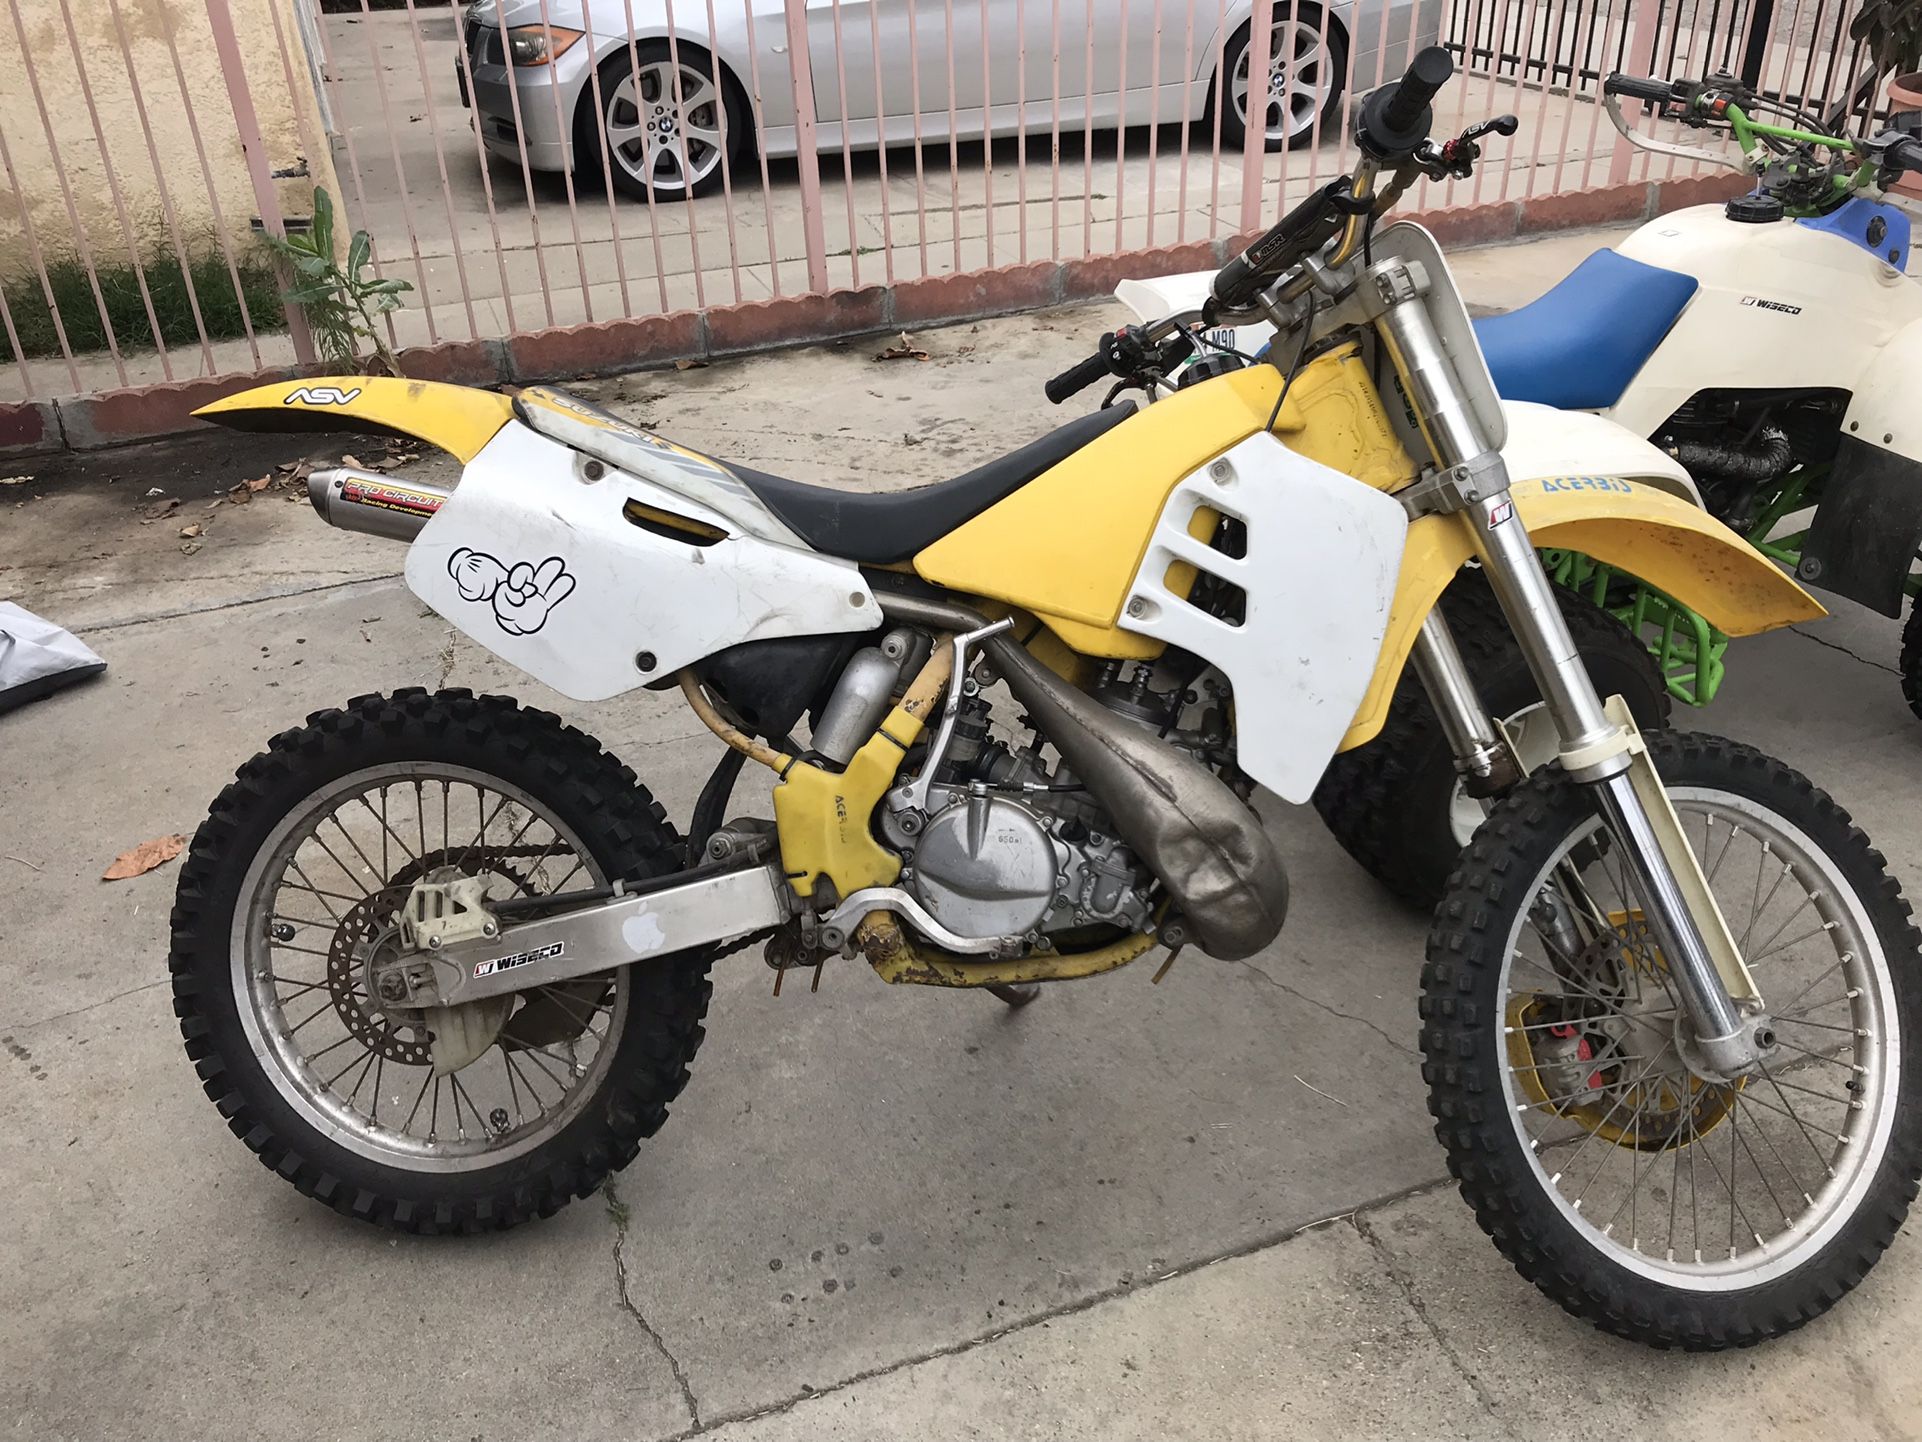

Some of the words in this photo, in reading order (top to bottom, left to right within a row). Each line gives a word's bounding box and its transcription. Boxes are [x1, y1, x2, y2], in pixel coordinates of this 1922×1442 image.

[284, 387, 362, 405] ASV
[347, 481, 382, 496] PRO
[382, 487, 446, 507] CIRCUIT
